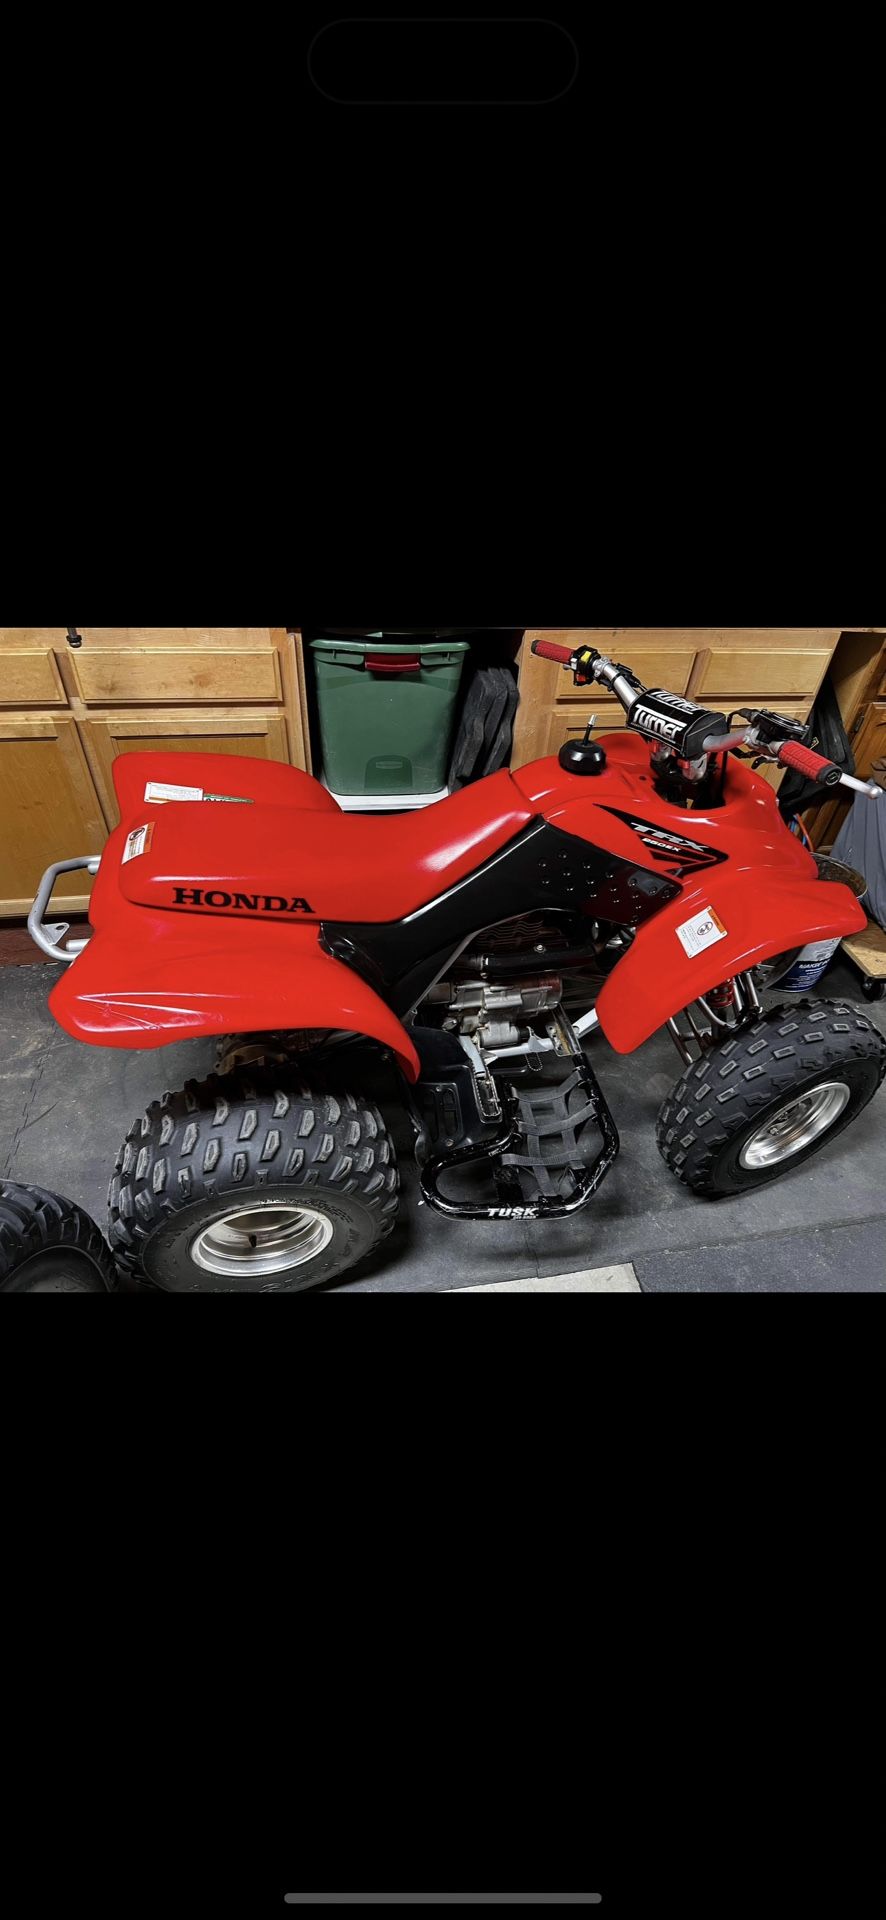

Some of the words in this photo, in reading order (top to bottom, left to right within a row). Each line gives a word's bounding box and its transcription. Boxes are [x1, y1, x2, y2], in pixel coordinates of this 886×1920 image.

[633, 703, 688, 740] Turner
[631, 822, 709, 852] TRX
[172, 887, 316, 914] HONDA
[488, 1206, 539, 1217] TUSK
